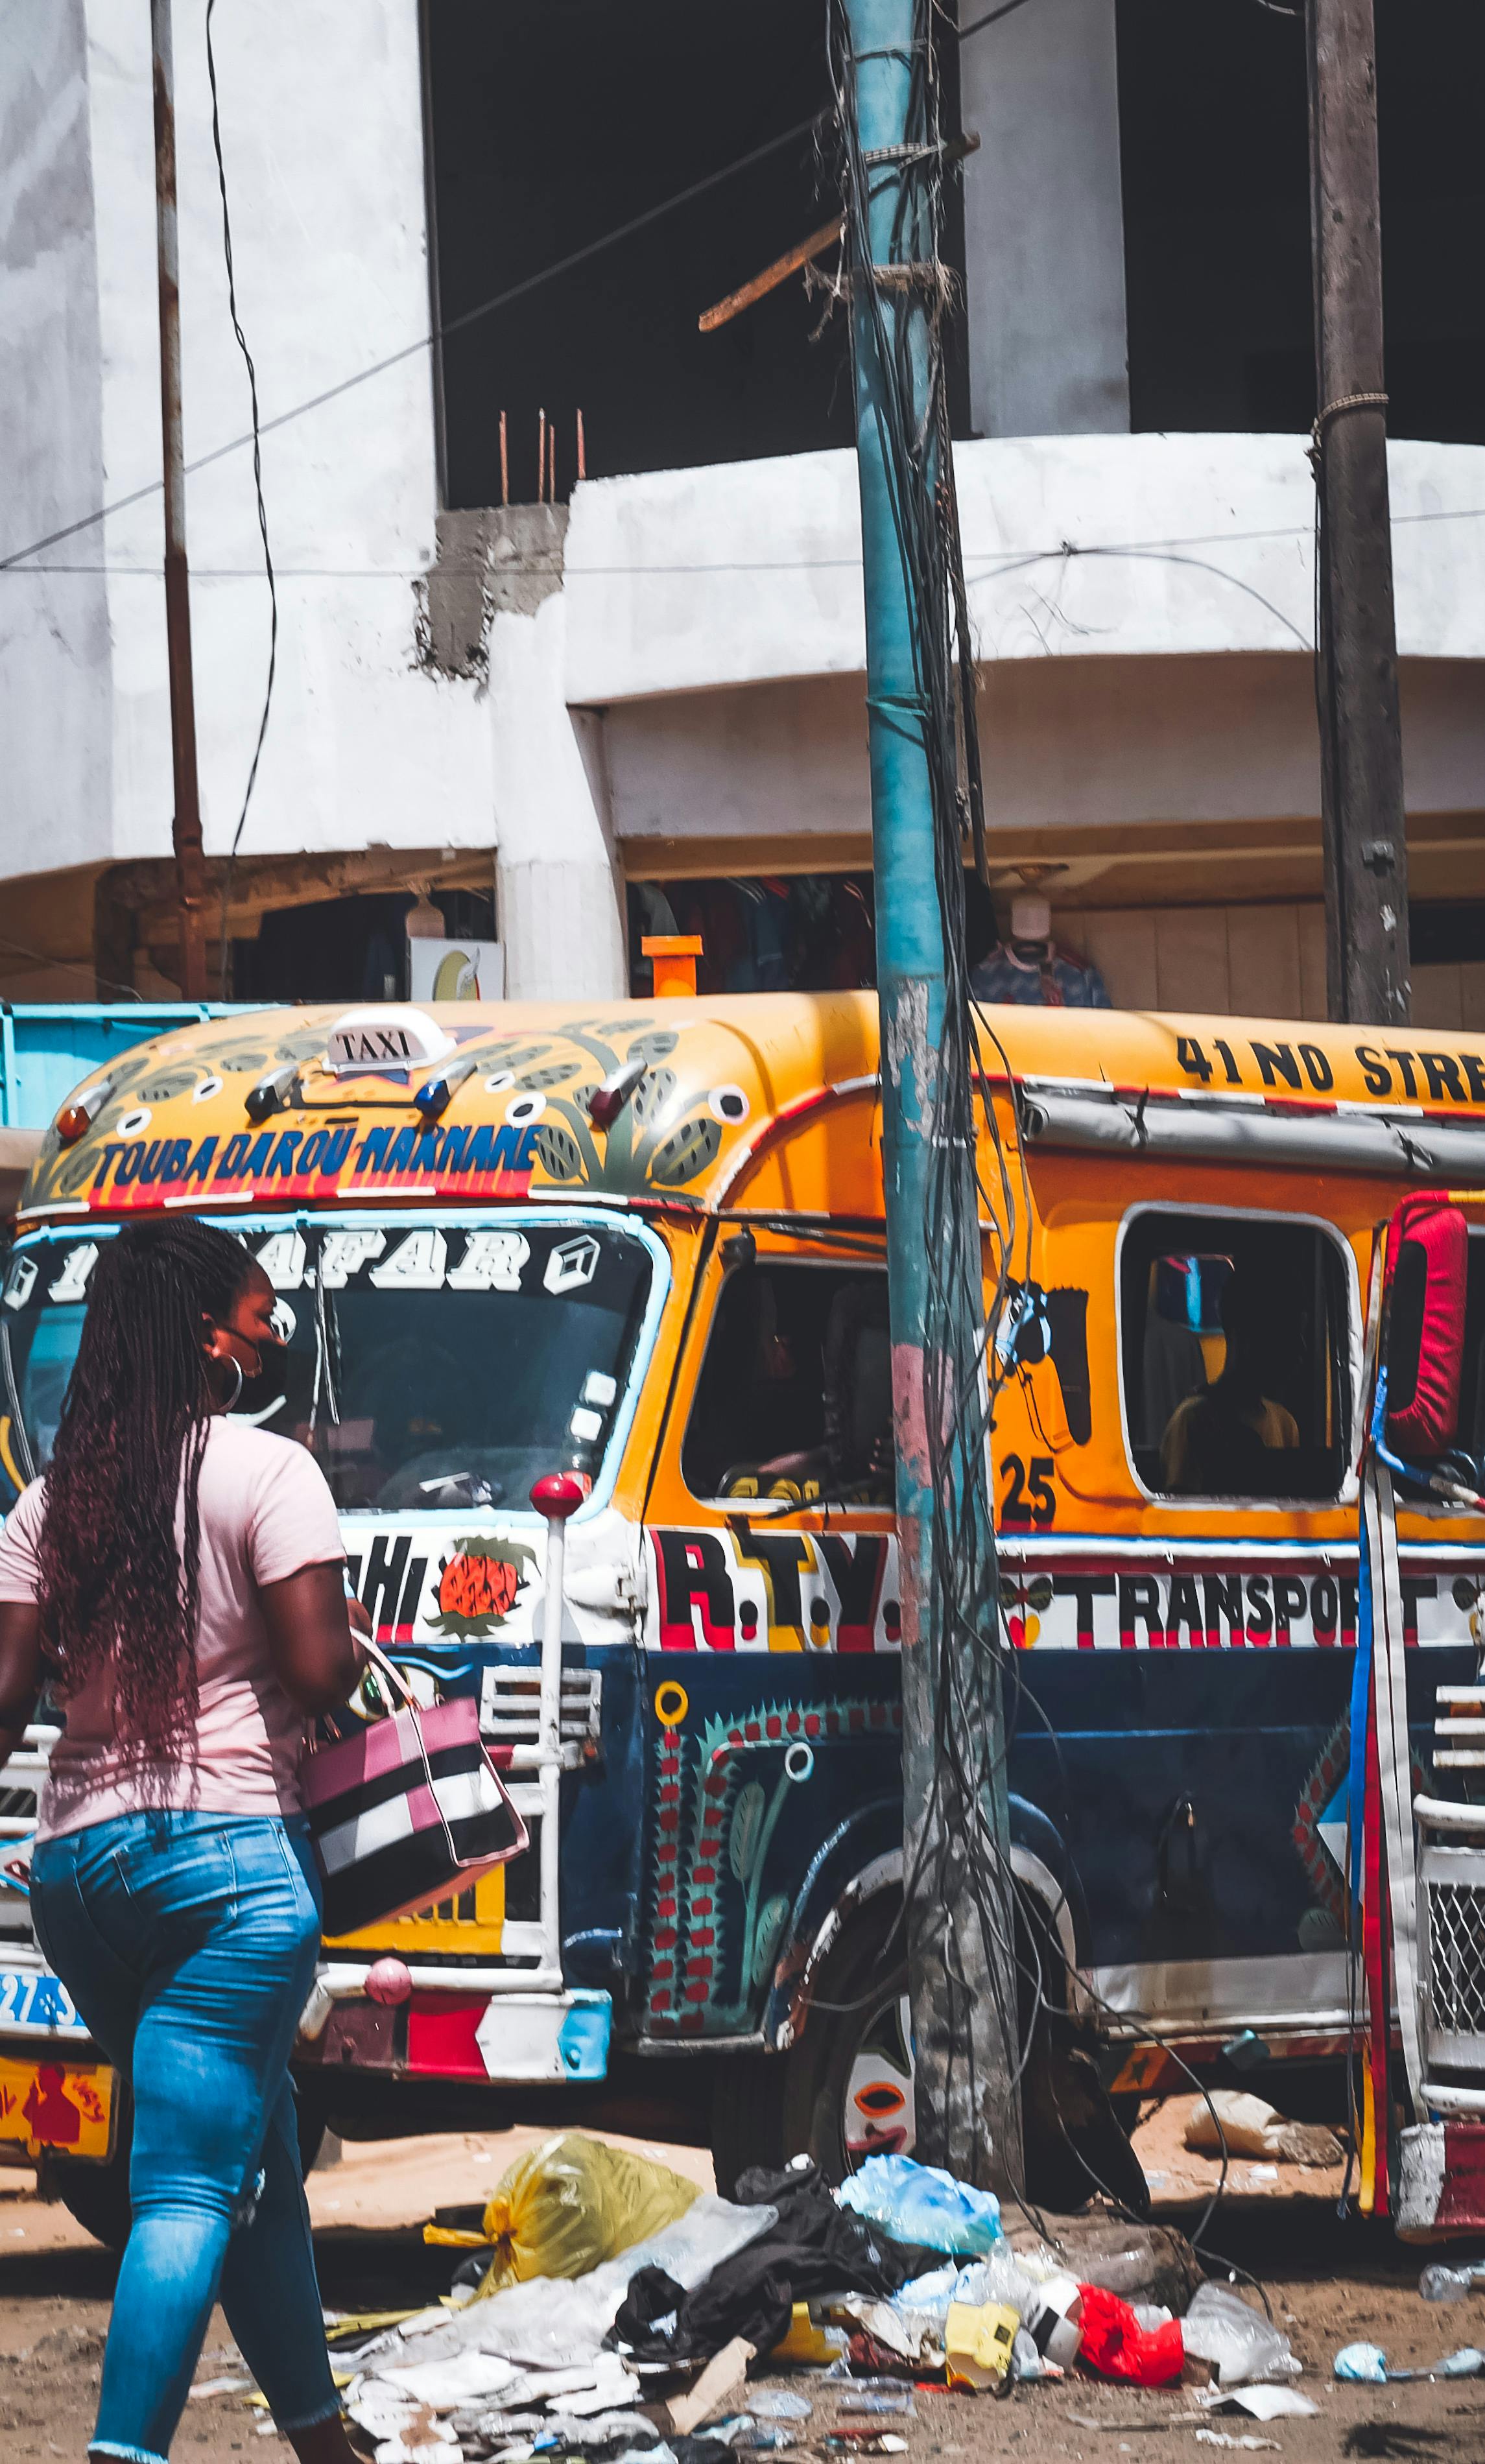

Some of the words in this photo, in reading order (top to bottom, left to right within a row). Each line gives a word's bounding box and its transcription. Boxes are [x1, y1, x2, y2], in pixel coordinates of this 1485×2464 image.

[336, 1030, 410, 1061] TAXI
[1176, 1037, 1242, 1084] 41
[93, 1136, 219, 1189] TOUBA
[215, 1127, 357, 1178] DAROU
[238, 1229, 530, 1292] AFAR
[1000, 1452, 1056, 1532] 25
